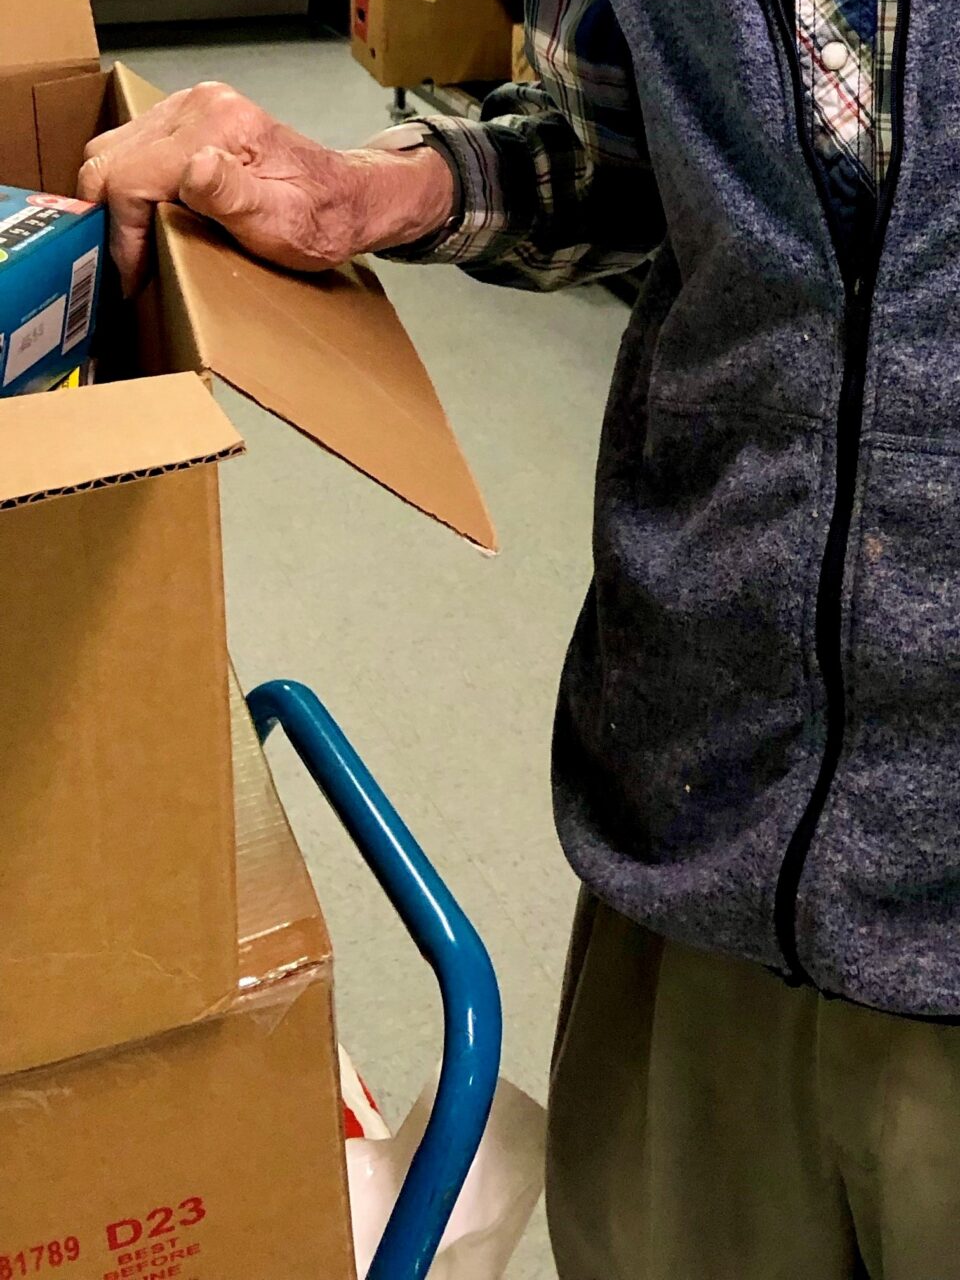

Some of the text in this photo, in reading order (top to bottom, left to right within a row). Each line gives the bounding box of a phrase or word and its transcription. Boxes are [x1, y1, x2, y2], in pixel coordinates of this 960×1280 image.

[105, 1196, 206, 1251] D23
[103, 1243, 201, 1280] BEFORE
[117, 1237, 180, 1265] BEST
